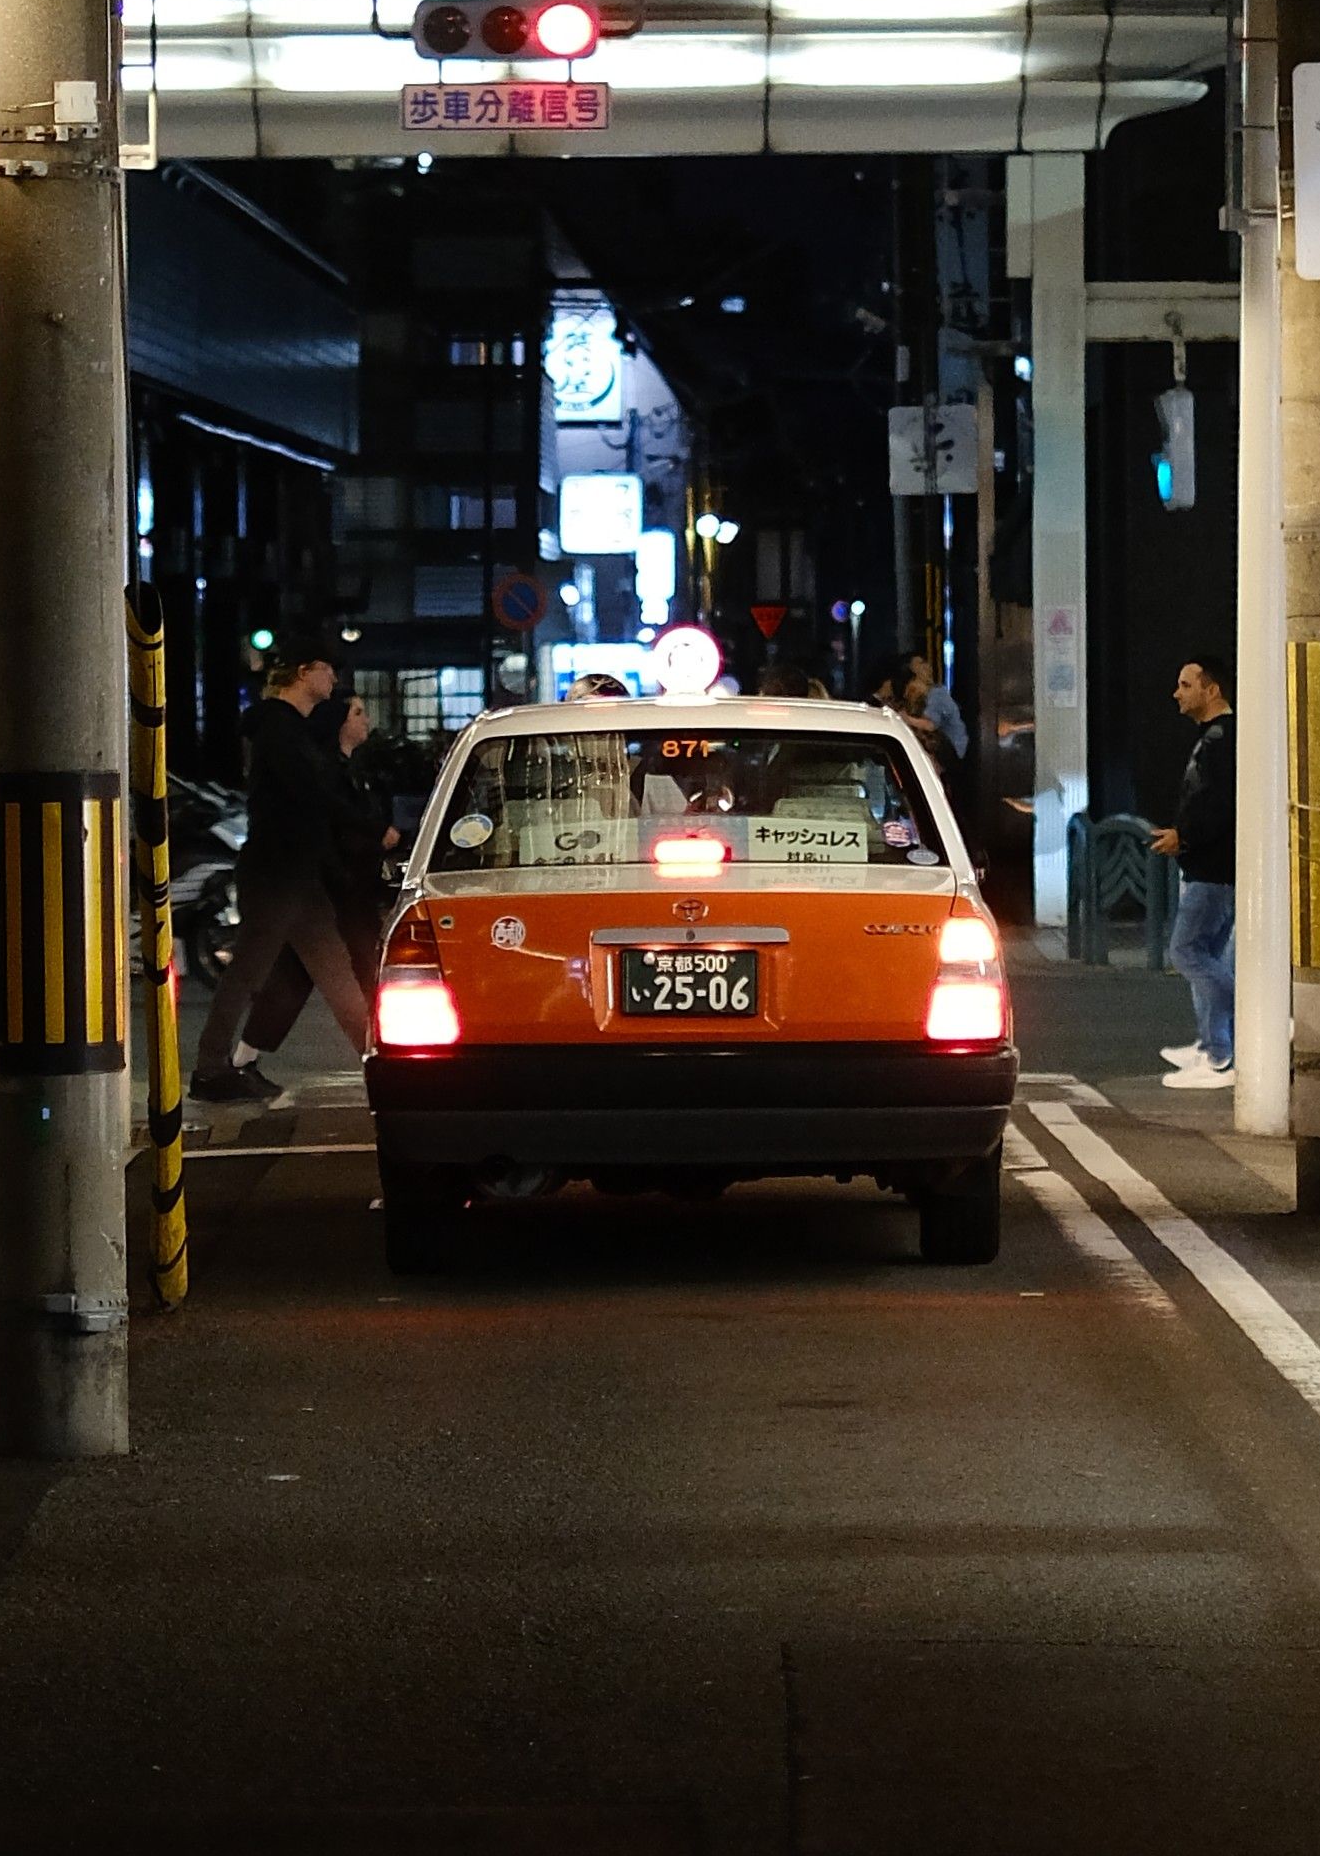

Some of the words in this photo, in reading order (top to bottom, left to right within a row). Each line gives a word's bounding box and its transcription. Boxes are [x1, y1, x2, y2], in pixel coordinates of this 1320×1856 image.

[410, 89, 601, 124] 歩車分離信号
[755, 826, 860, 848] キャッシュレス
[631, 986, 651, 1002] い
[653, 975, 750, 1011] 25-06
